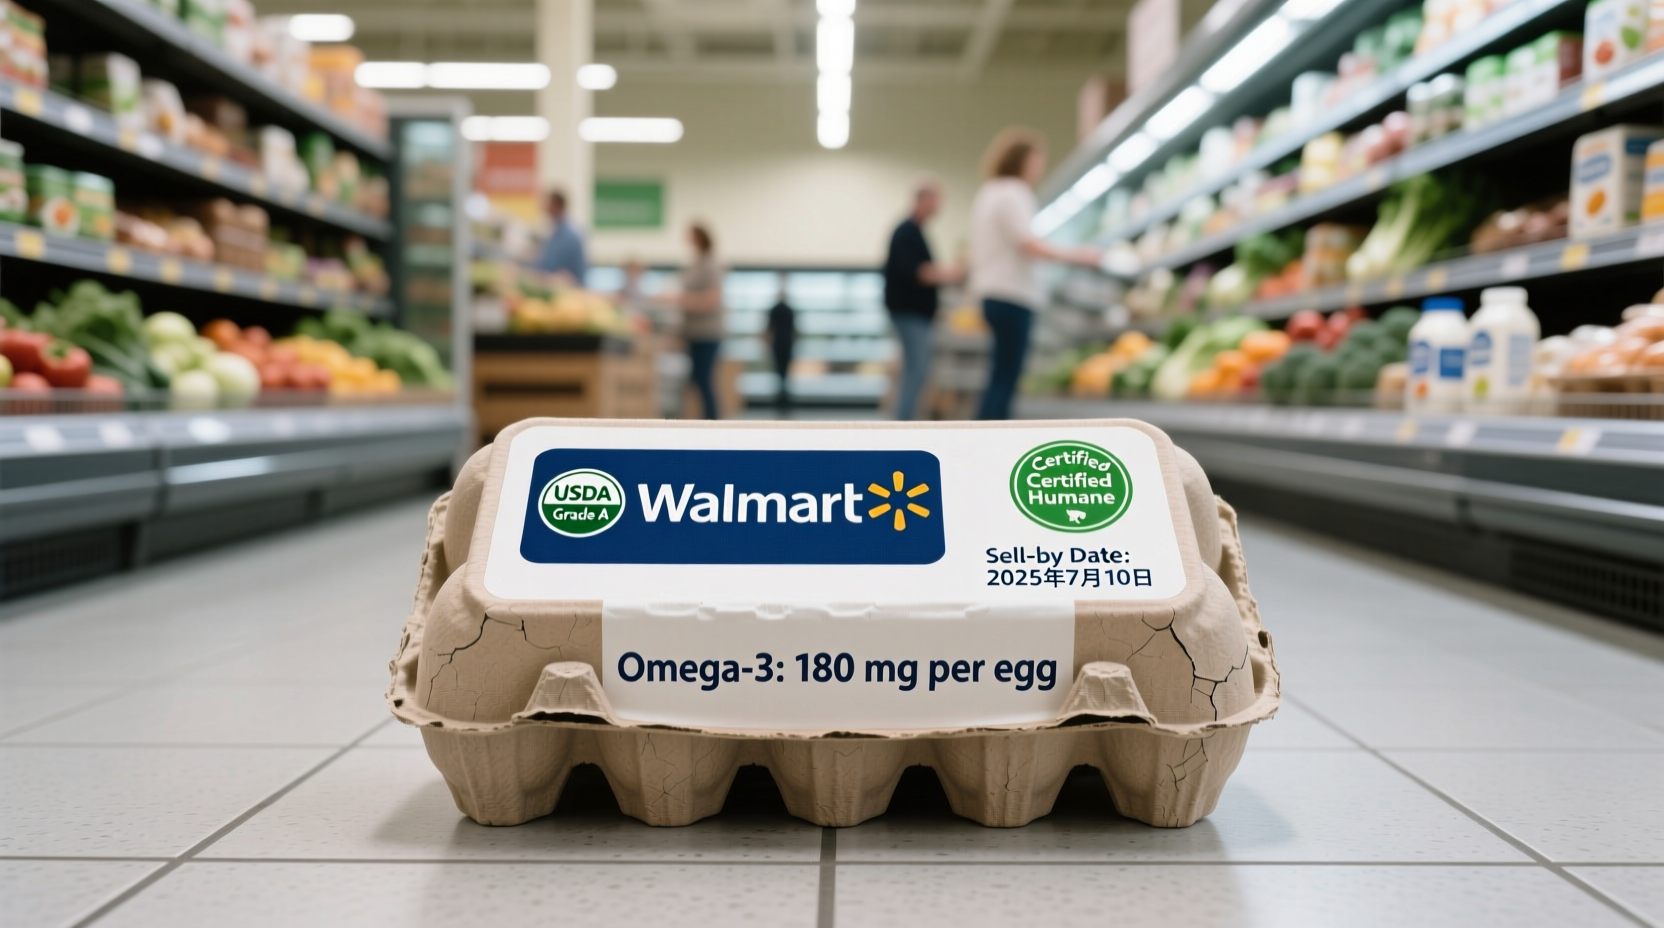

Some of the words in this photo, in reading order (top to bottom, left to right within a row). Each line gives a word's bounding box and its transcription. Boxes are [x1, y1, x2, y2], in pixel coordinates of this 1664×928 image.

[1026, 472, 1112, 488] Certified
[554, 484, 612, 502] USDA
[1028, 490, 1116, 505] Humane
[637, 483, 864, 524] Walmart
[552, 506, 596, 521] Grade
[598, 507, 609, 521] A
[985, 546, 1064, 568] Sell-by
[1070, 547, 1130, 564] Date:
[986, 568, 1152, 588] 2025年7月10日
[617, 651, 785, 692] Omega-3:
[795, 652, 855, 683] 180
[864, 659, 919, 692] mg
[928, 659, 986, 692] per
[993, 659, 1057, 692] egg
